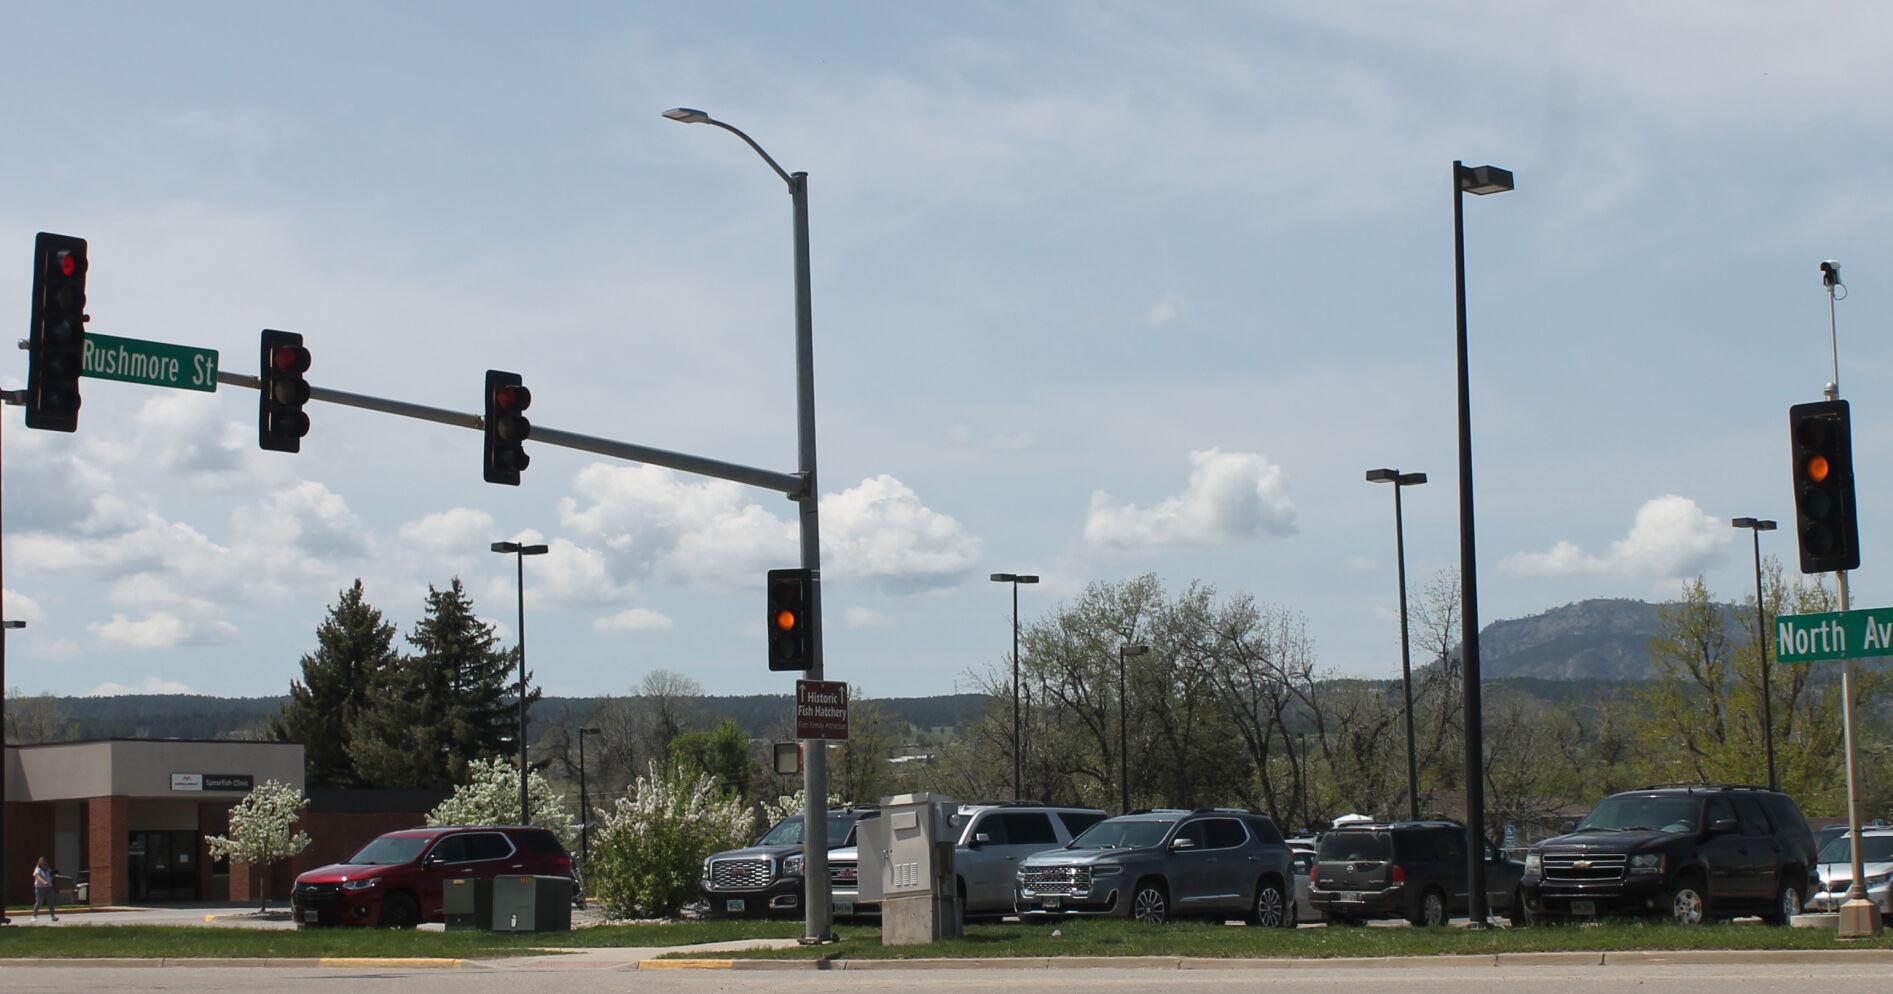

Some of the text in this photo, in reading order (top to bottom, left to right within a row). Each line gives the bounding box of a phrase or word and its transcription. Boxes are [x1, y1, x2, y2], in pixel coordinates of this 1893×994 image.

[82, 338, 214, 386] Rushmore St
[1779, 619, 1846, 656] North
[807, 691, 838, 704] Historic
[798, 704, 846, 721] Fish Hatchery
[205, 778, 232, 787] Spearfish
[232, 778, 249, 787] Clinic
